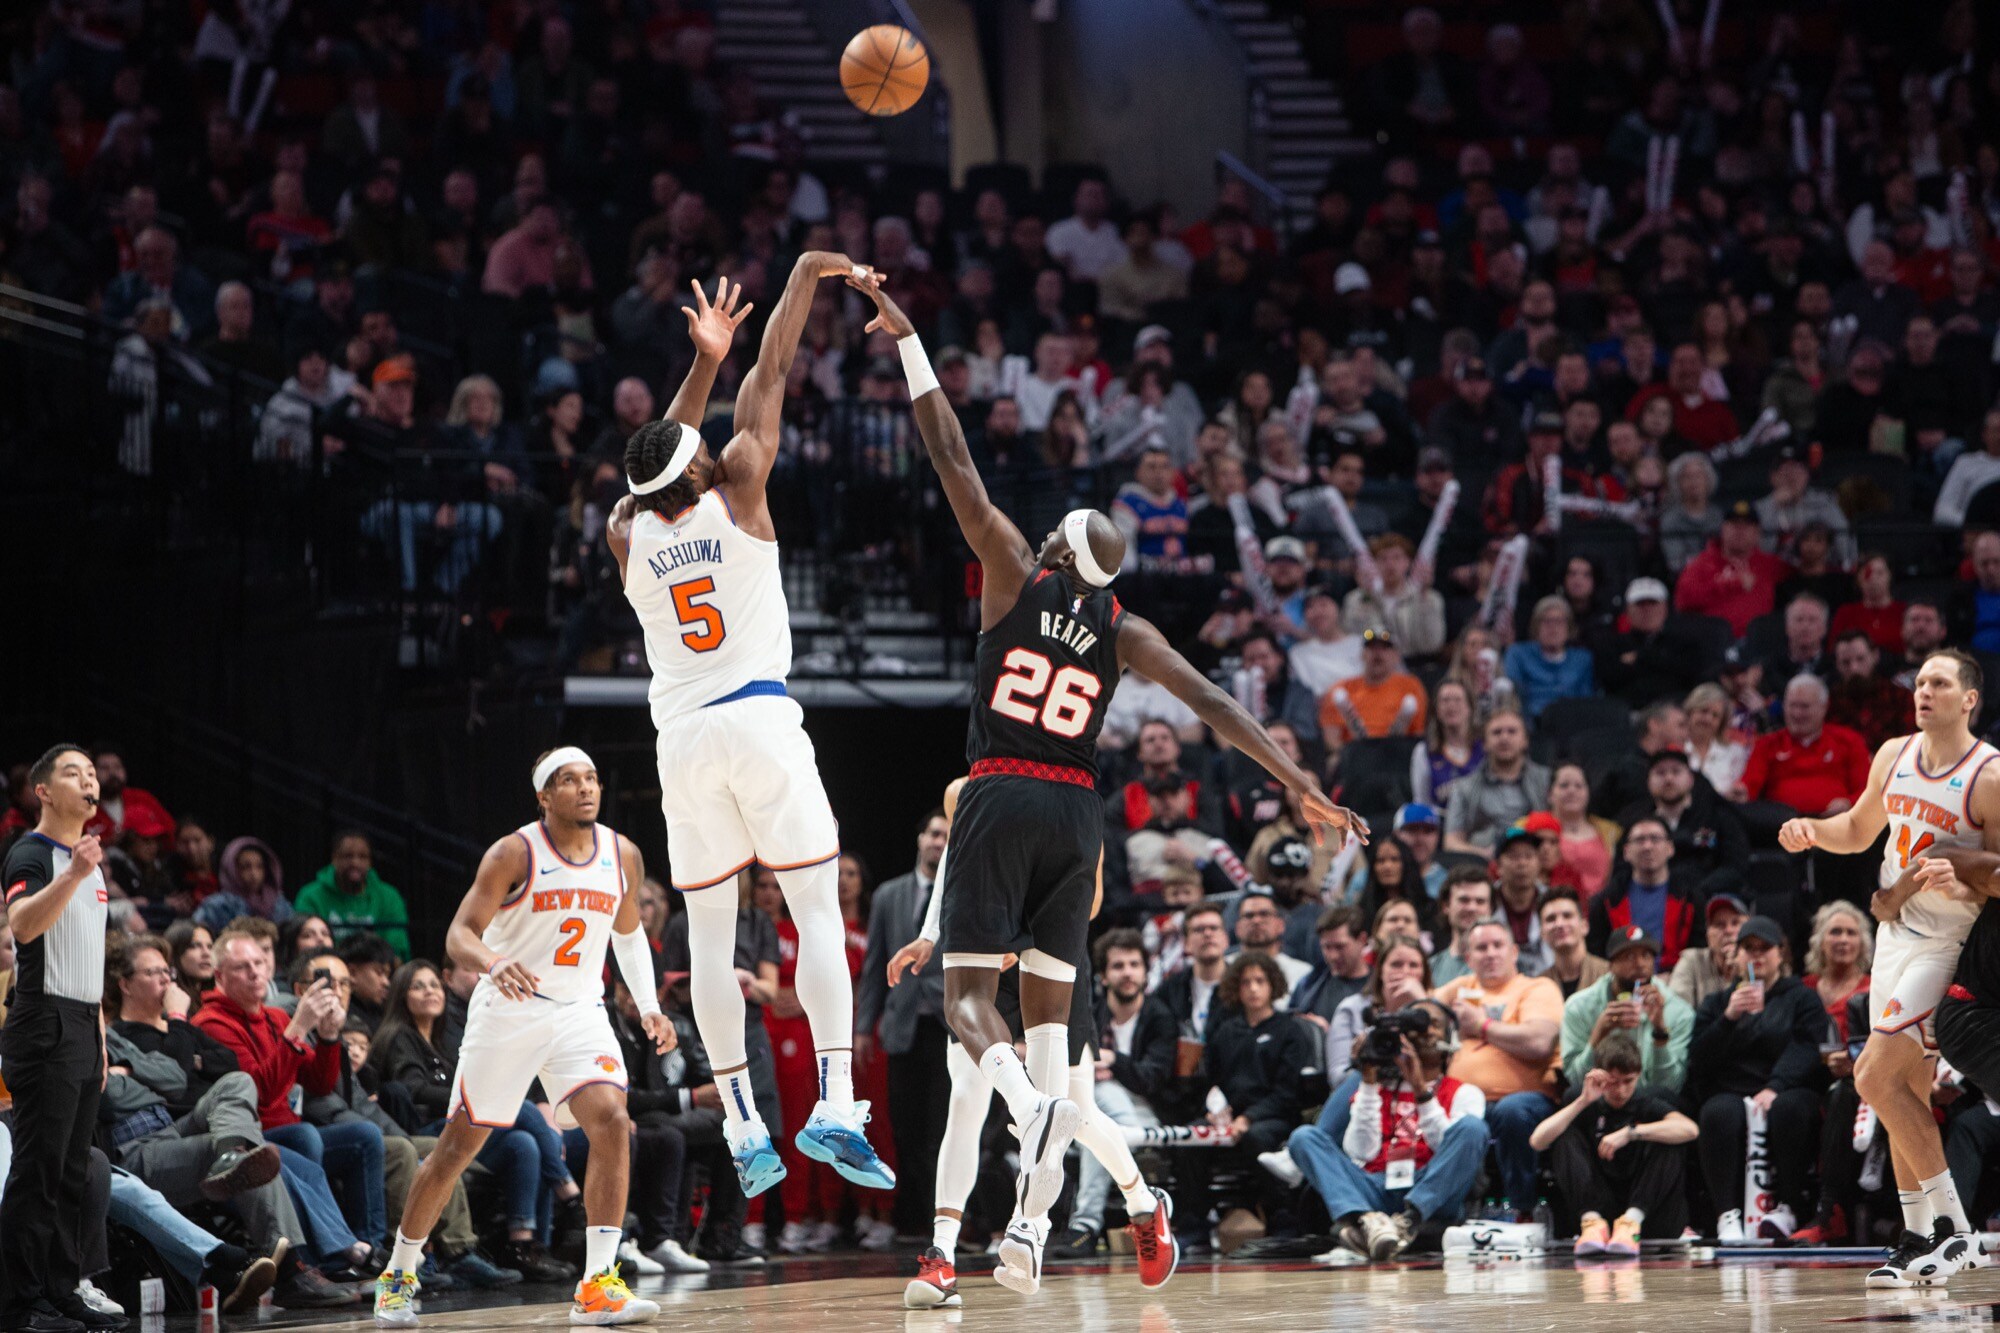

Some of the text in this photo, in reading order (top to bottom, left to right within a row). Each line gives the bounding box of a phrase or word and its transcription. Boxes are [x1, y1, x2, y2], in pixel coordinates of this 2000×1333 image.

[648, 539, 723, 579] ACHIUWA
[669, 575, 726, 653] 5
[1040, 611, 1097, 656] REATH
[988, 645, 1102, 738] 26
[1887, 793, 1960, 835] NEW YORK
[532, 888, 617, 917] NEW YORK
[553, 917, 587, 967] 2
